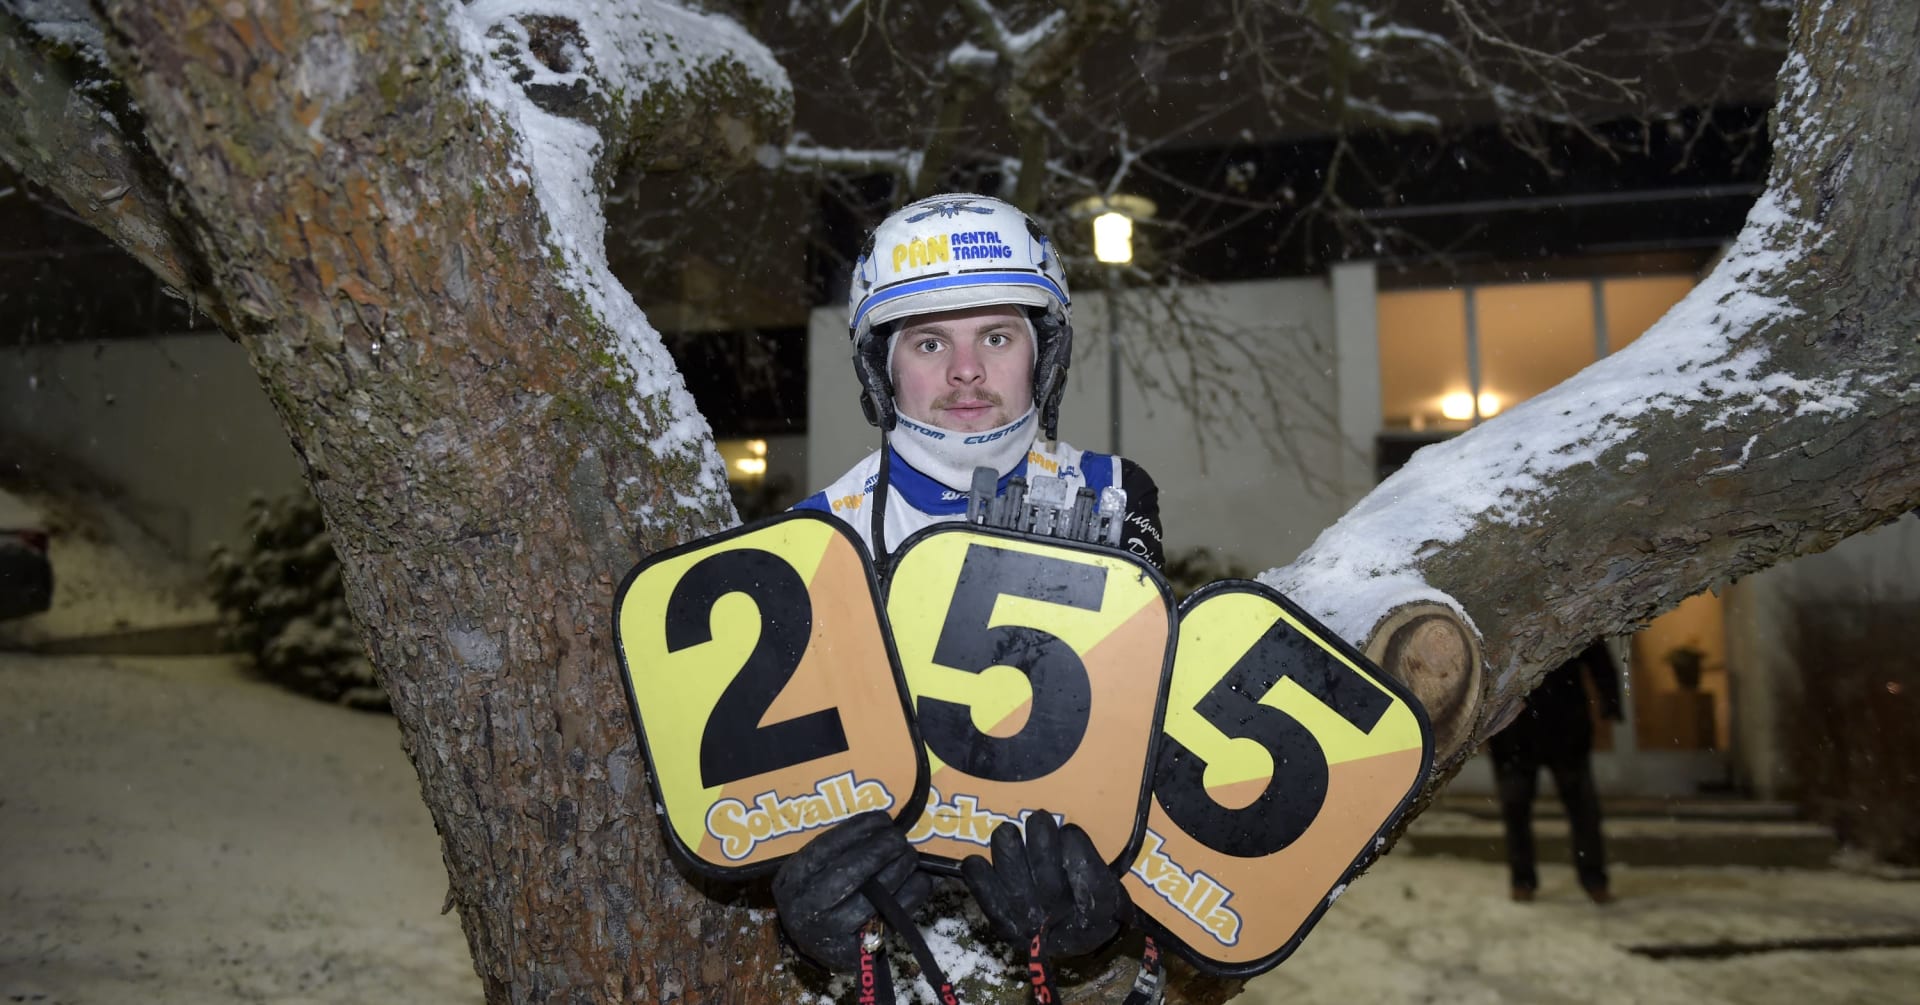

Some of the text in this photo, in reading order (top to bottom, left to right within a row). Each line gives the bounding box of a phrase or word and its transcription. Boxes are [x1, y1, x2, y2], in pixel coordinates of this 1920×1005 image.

[892, 231, 1002, 272] PAN RENTAL
[952, 245, 1012, 261] TRADING
[896, 415, 946, 440] USTOM
[963, 415, 1029, 445] CUSTOM
[665, 548, 849, 789] 2
[917, 543, 1107, 782] 5
[1154, 618, 1394, 858] 5
[705, 770, 895, 861] Solvalla
[1129, 827, 1242, 947] lvalla
